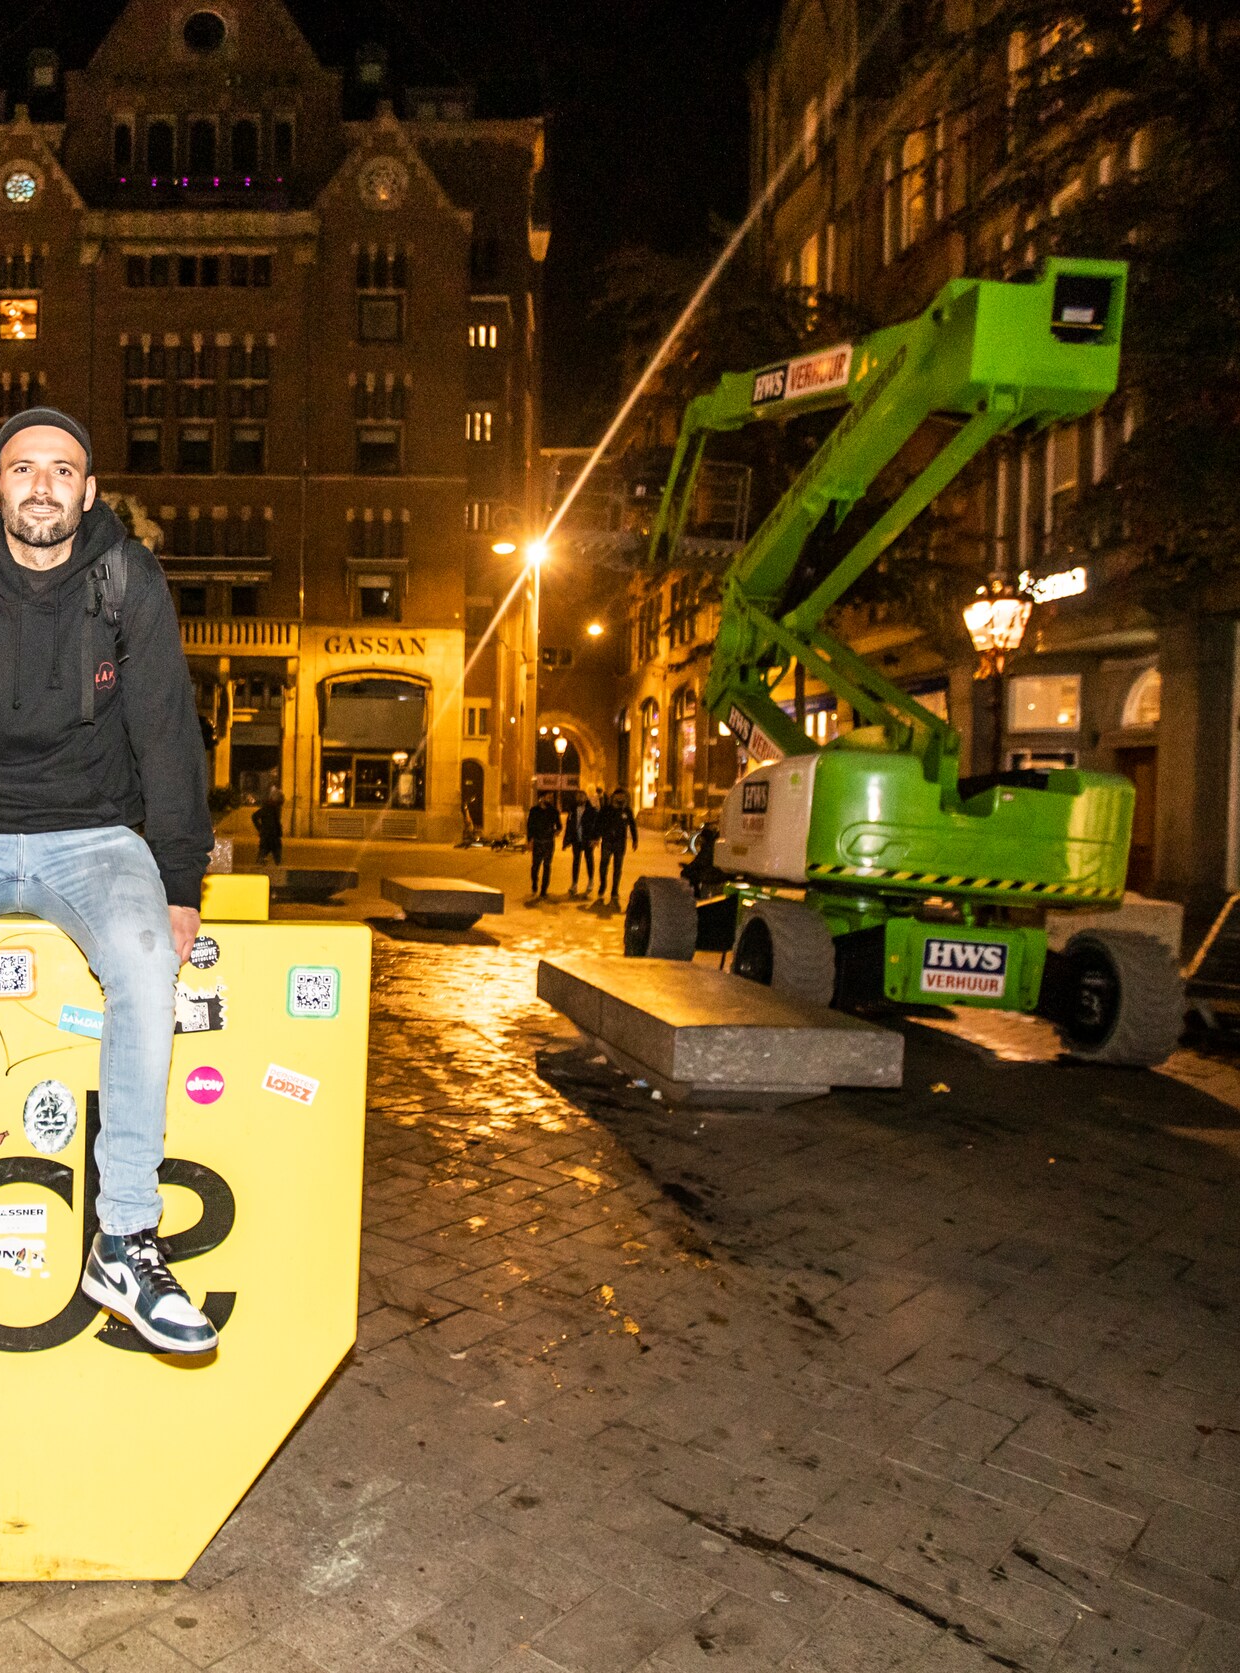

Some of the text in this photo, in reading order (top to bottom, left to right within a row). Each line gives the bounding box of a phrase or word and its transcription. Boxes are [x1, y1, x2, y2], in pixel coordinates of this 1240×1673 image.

[753, 369, 785, 402] HWS
[324, 636, 426, 656] GASSAN
[190, 946, 217, 959] GROOVE
[927, 942, 1002, 971] HWS
[926, 973, 999, 992] VERHUUR
[186, 1076, 223, 1091] elrow
